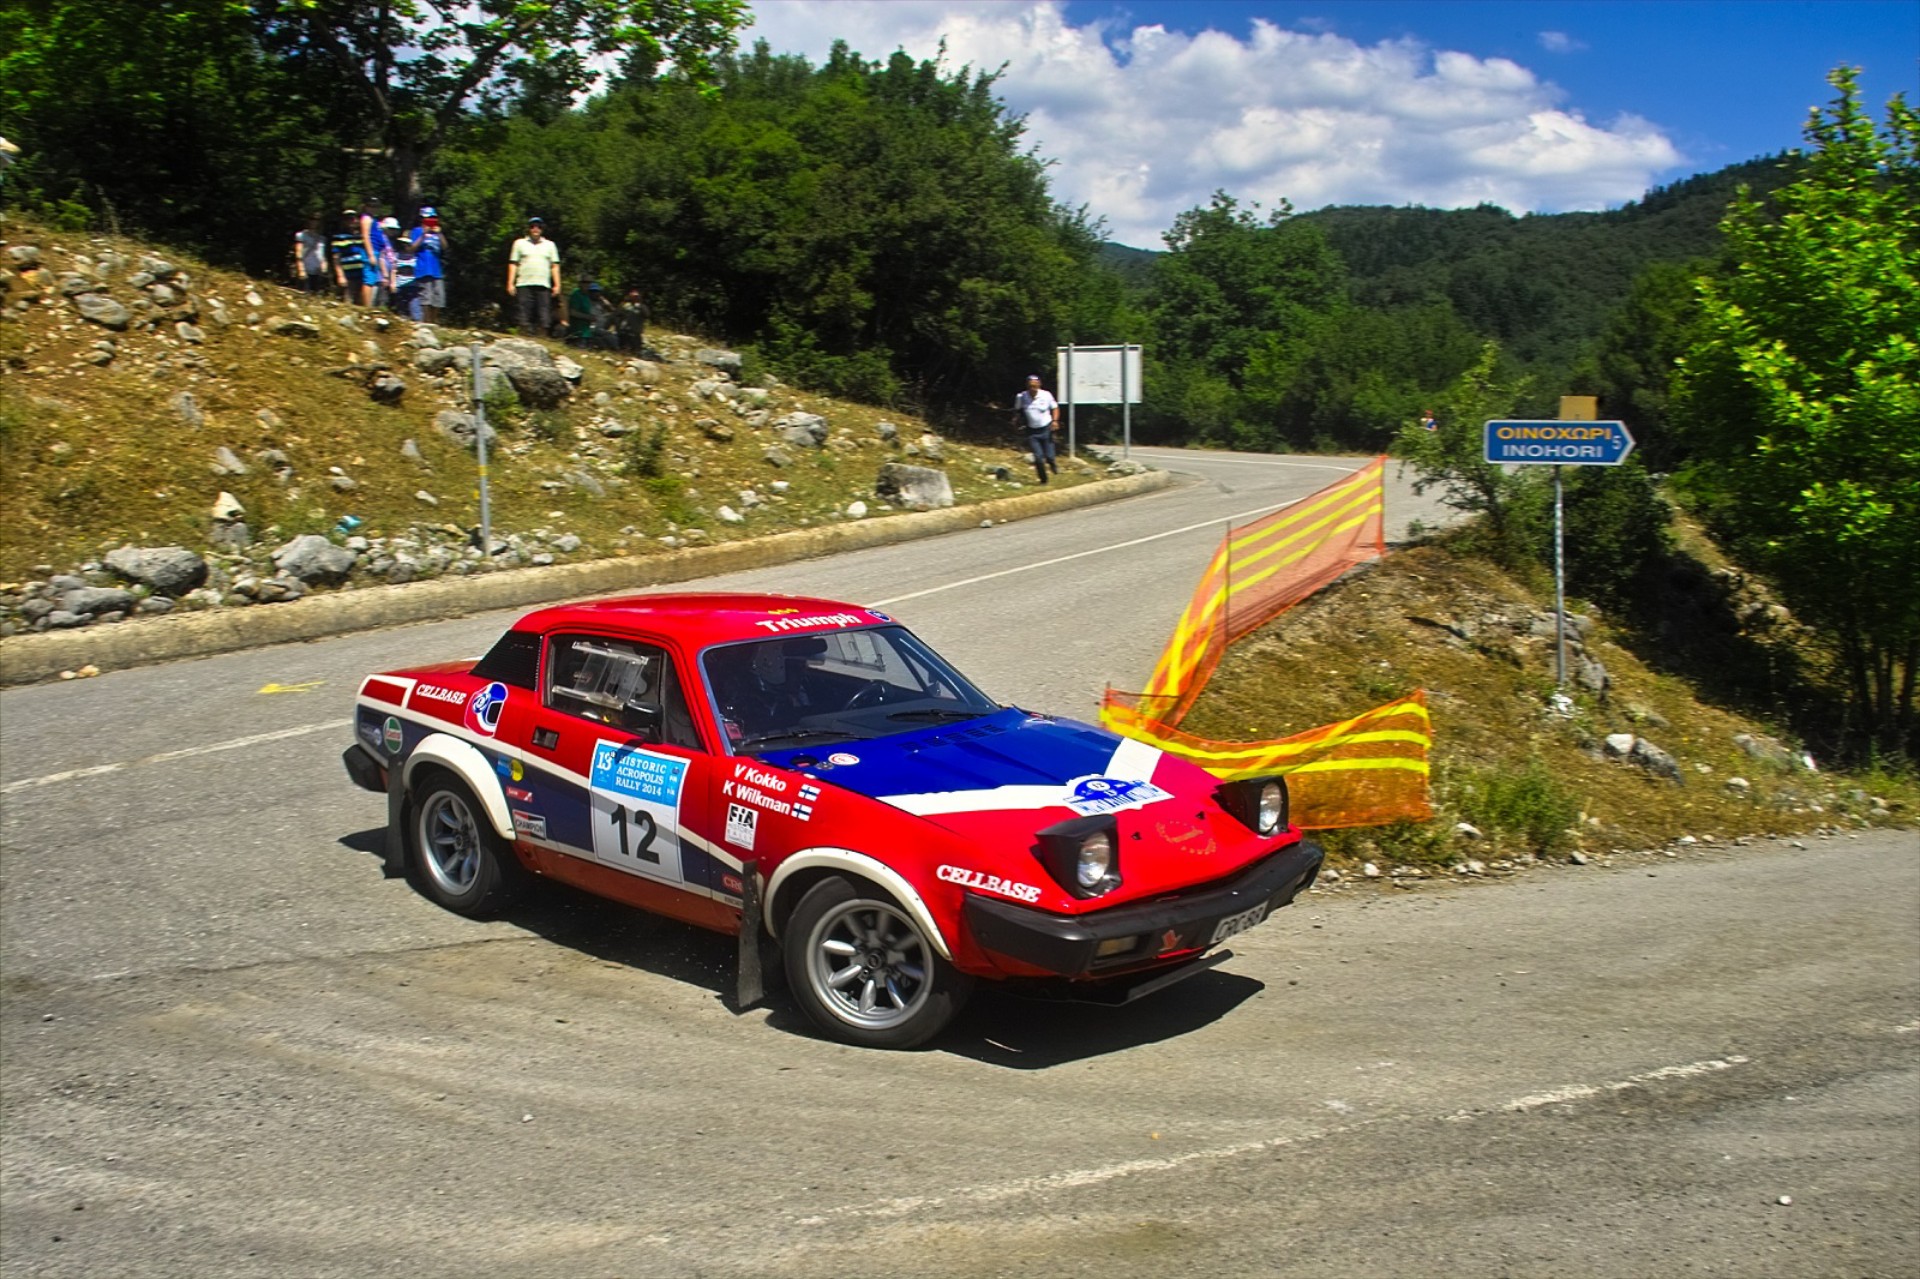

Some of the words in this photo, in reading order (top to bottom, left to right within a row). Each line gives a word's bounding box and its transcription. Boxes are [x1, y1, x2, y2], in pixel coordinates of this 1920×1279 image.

[1496, 426, 1612, 441] ΟΙΝΟΧΩΡΙ
[1611, 435, 1623, 450] 5
[1501, 444, 1604, 458] INOHORI
[755, 612, 863, 632] Triumph
[415, 684, 468, 705] CELLBASE
[618, 755, 668, 774] HISTORIC
[616, 766, 665, 786] ACROPOLIS
[733, 763, 747, 778] V
[743, 767, 787, 792] Kokko
[615, 776, 641, 791] RALLY
[641, 783, 663, 797] 2014
[722, 779, 736, 796] K
[735, 783, 791, 815] Wilkman
[610, 803, 661, 866] 12
[936, 864, 1042, 903] CELLBASE
